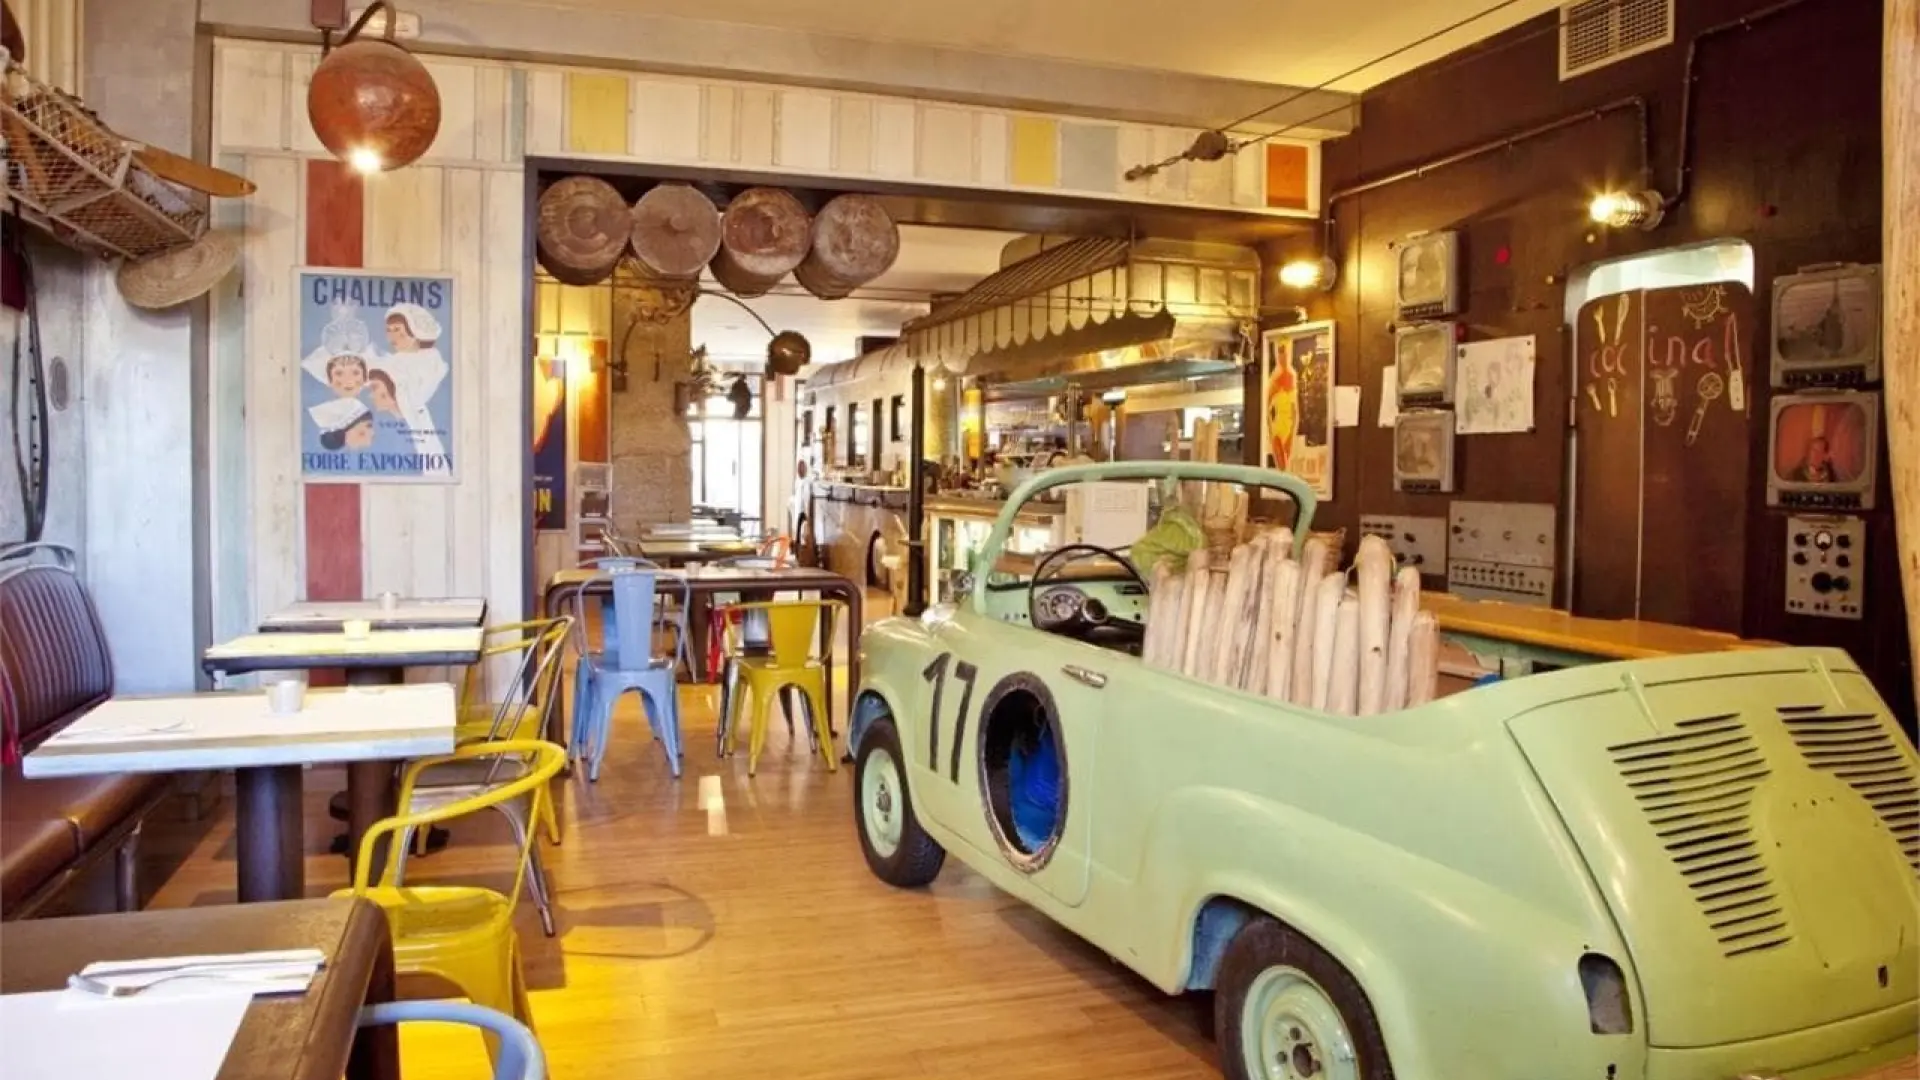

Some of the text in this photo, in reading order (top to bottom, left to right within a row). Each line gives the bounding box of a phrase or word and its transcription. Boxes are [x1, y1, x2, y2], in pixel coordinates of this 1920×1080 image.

[313, 277, 444, 309] CHALLANS
[302, 452, 454, 475] FOIRE EXPOSITION
[922, 651, 978, 785] 17
